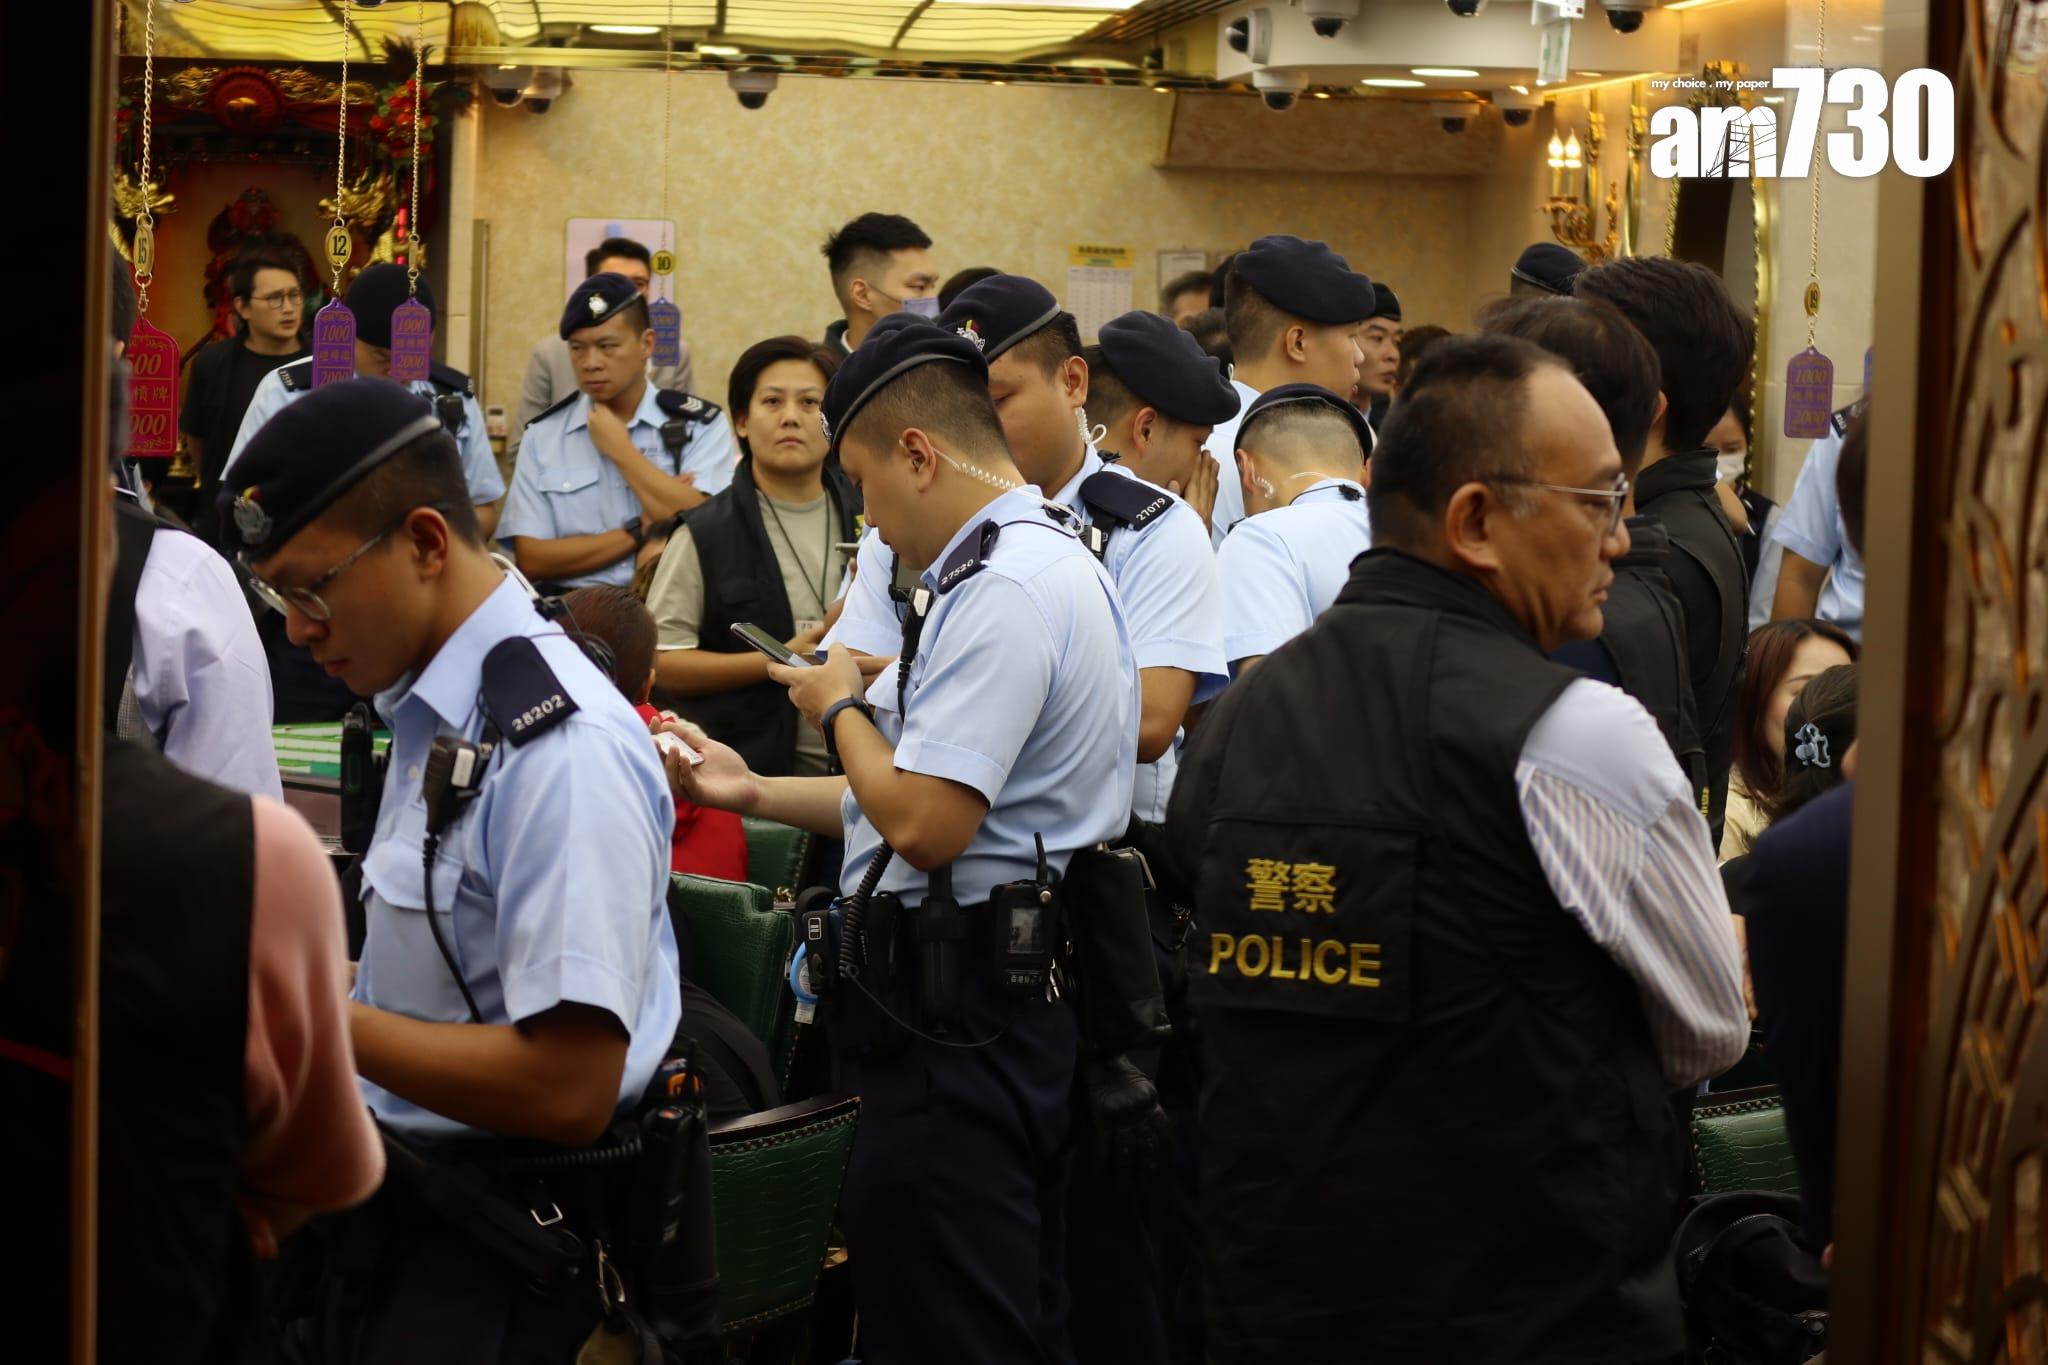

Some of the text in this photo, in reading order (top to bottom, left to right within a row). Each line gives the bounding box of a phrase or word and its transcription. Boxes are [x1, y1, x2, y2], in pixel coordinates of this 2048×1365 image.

[137, 237, 148, 264] 15
[332, 235, 347, 256] 12
[656, 255, 671, 270] 10
[321, 325, 350, 342] 1000
[1135, 497, 1166, 521] 27079
[941, 559, 974, 585] 27520
[511, 694, 566, 732] 28202
[1245, 857, 1337, 913] 警察
[1208, 932, 1382, 988] POLICE
